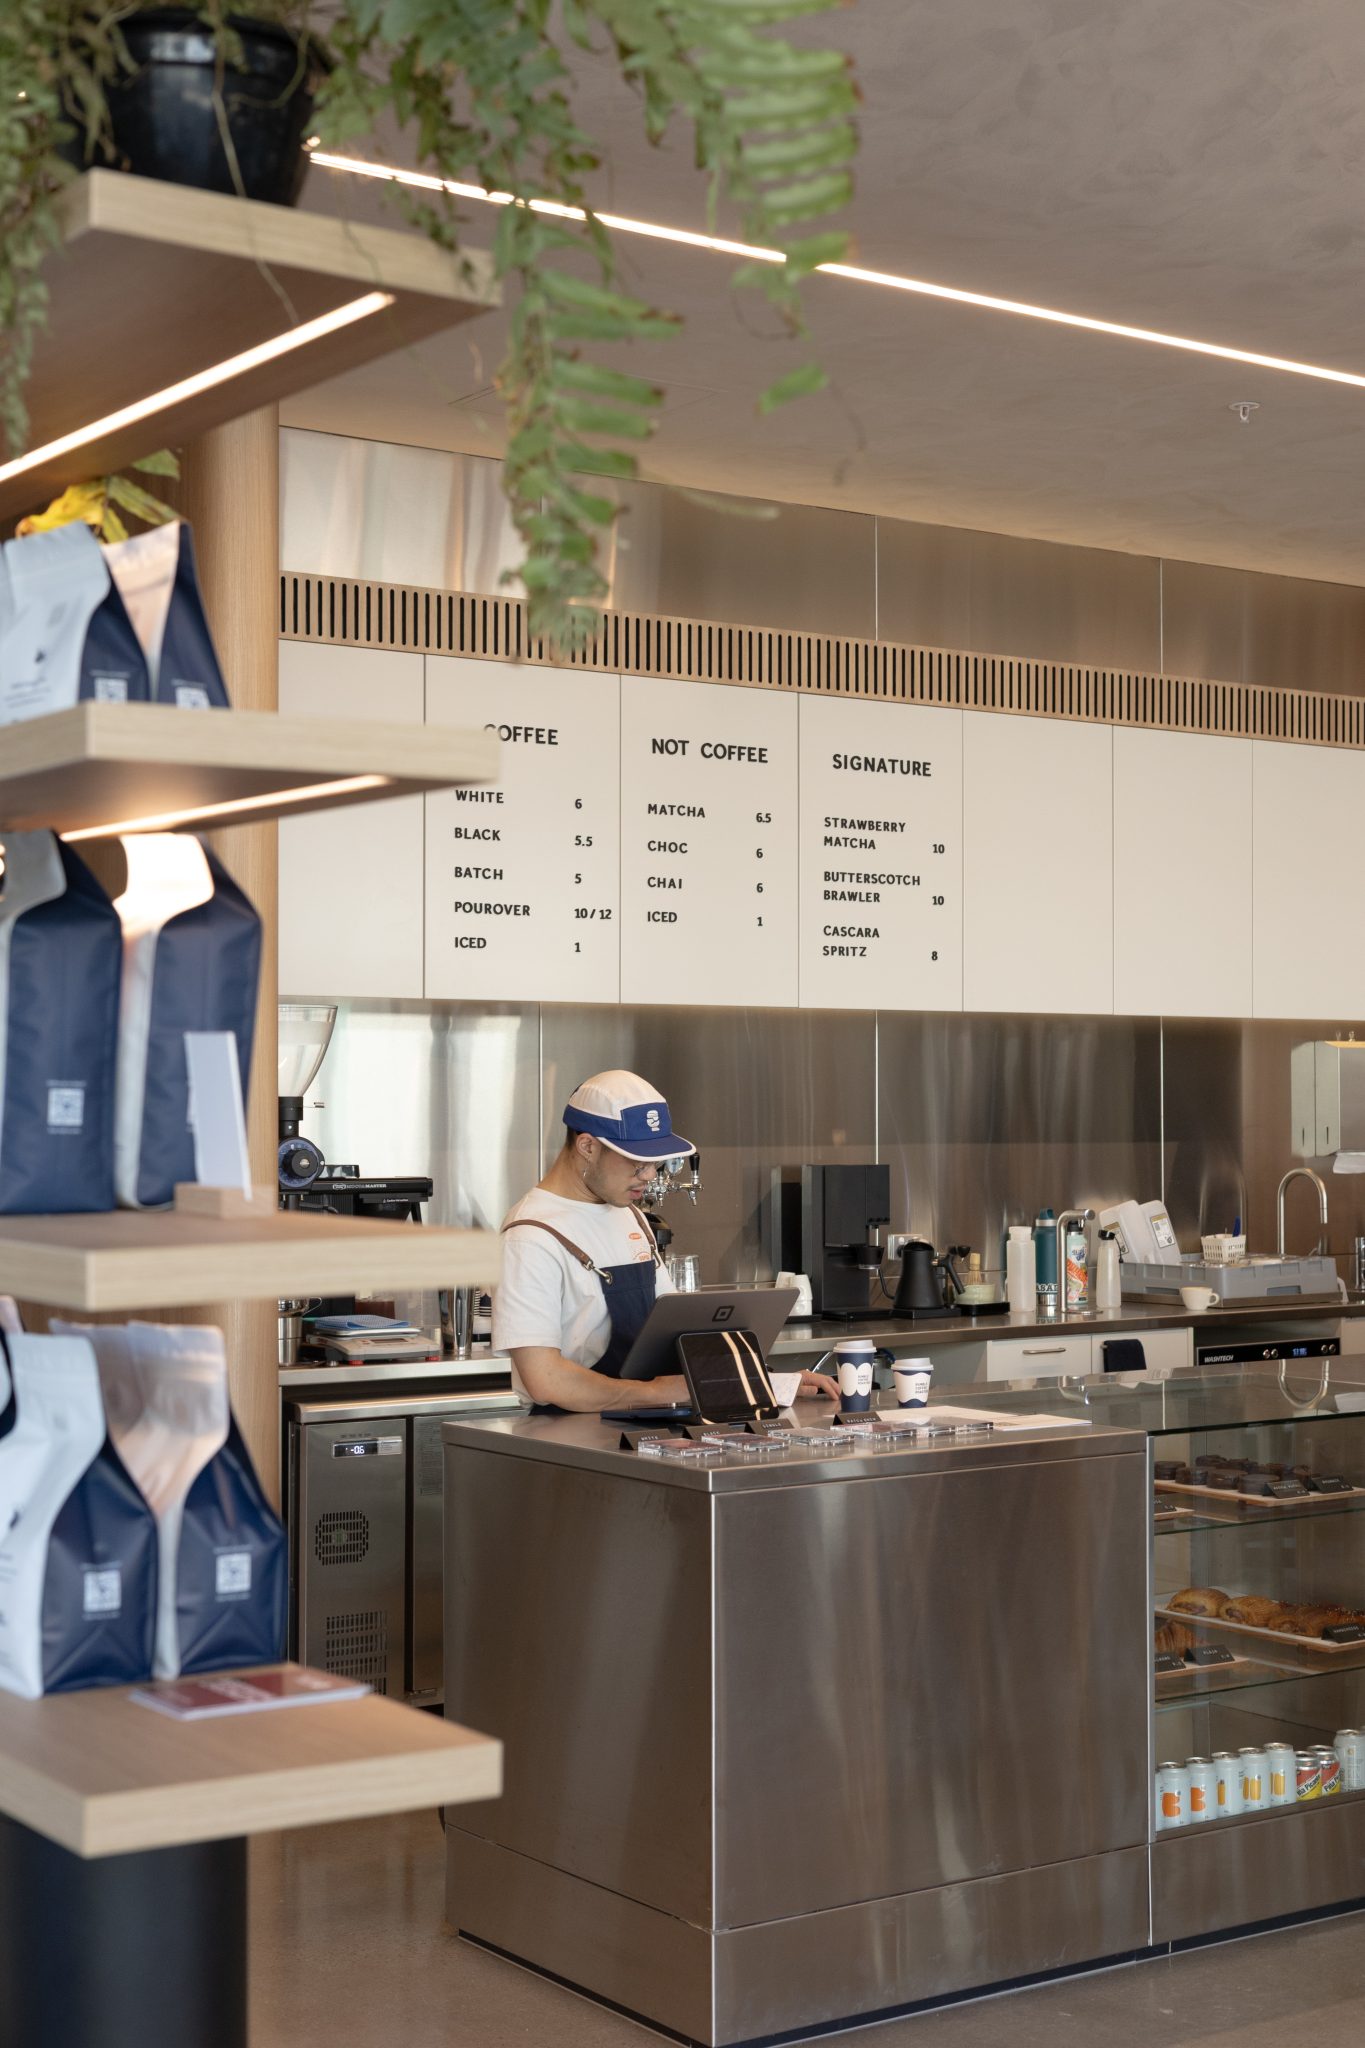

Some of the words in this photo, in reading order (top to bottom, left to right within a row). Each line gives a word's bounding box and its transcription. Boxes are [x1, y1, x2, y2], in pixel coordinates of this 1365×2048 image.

[651, 737, 690, 756] NOT
[700, 742, 769, 764] COFFEE
[832, 753, 932, 778] SIGNATURE
[455, 789, 505, 804] WHITE
[574, 798, 583, 810] 6
[647, 803, 706, 819] MATCHA
[755, 812, 772, 824] 6.5
[823, 816, 907, 833] STRAWBERRY
[454, 826, 501, 842] BLACK
[574, 834, 593, 848] 5.5
[823, 835, 877, 850] MATCHA
[932, 843, 946, 855] 10
[647, 839, 689, 855] CHOC
[755, 847, 764, 859] 6
[454, 866, 504, 881] BATCH
[574, 872, 582, 885] 5
[823, 870, 921, 887] BUTTERSCOTCH
[646, 876, 683, 890] CHAI
[756, 882, 764, 894] 6
[823, 889, 881, 903] BRAWLER
[931, 895, 945, 906] 10
[454, 901, 531, 917] POUROVER
[647, 910, 678, 924] ICED
[756, 916, 764, 927] 1
[822, 924, 881, 939] CASCARA
[454, 936, 487, 950] ICED
[574, 941, 582, 953] 1
[822, 945, 868, 958] SPRITZ
[930, 950, 939, 962] 8
